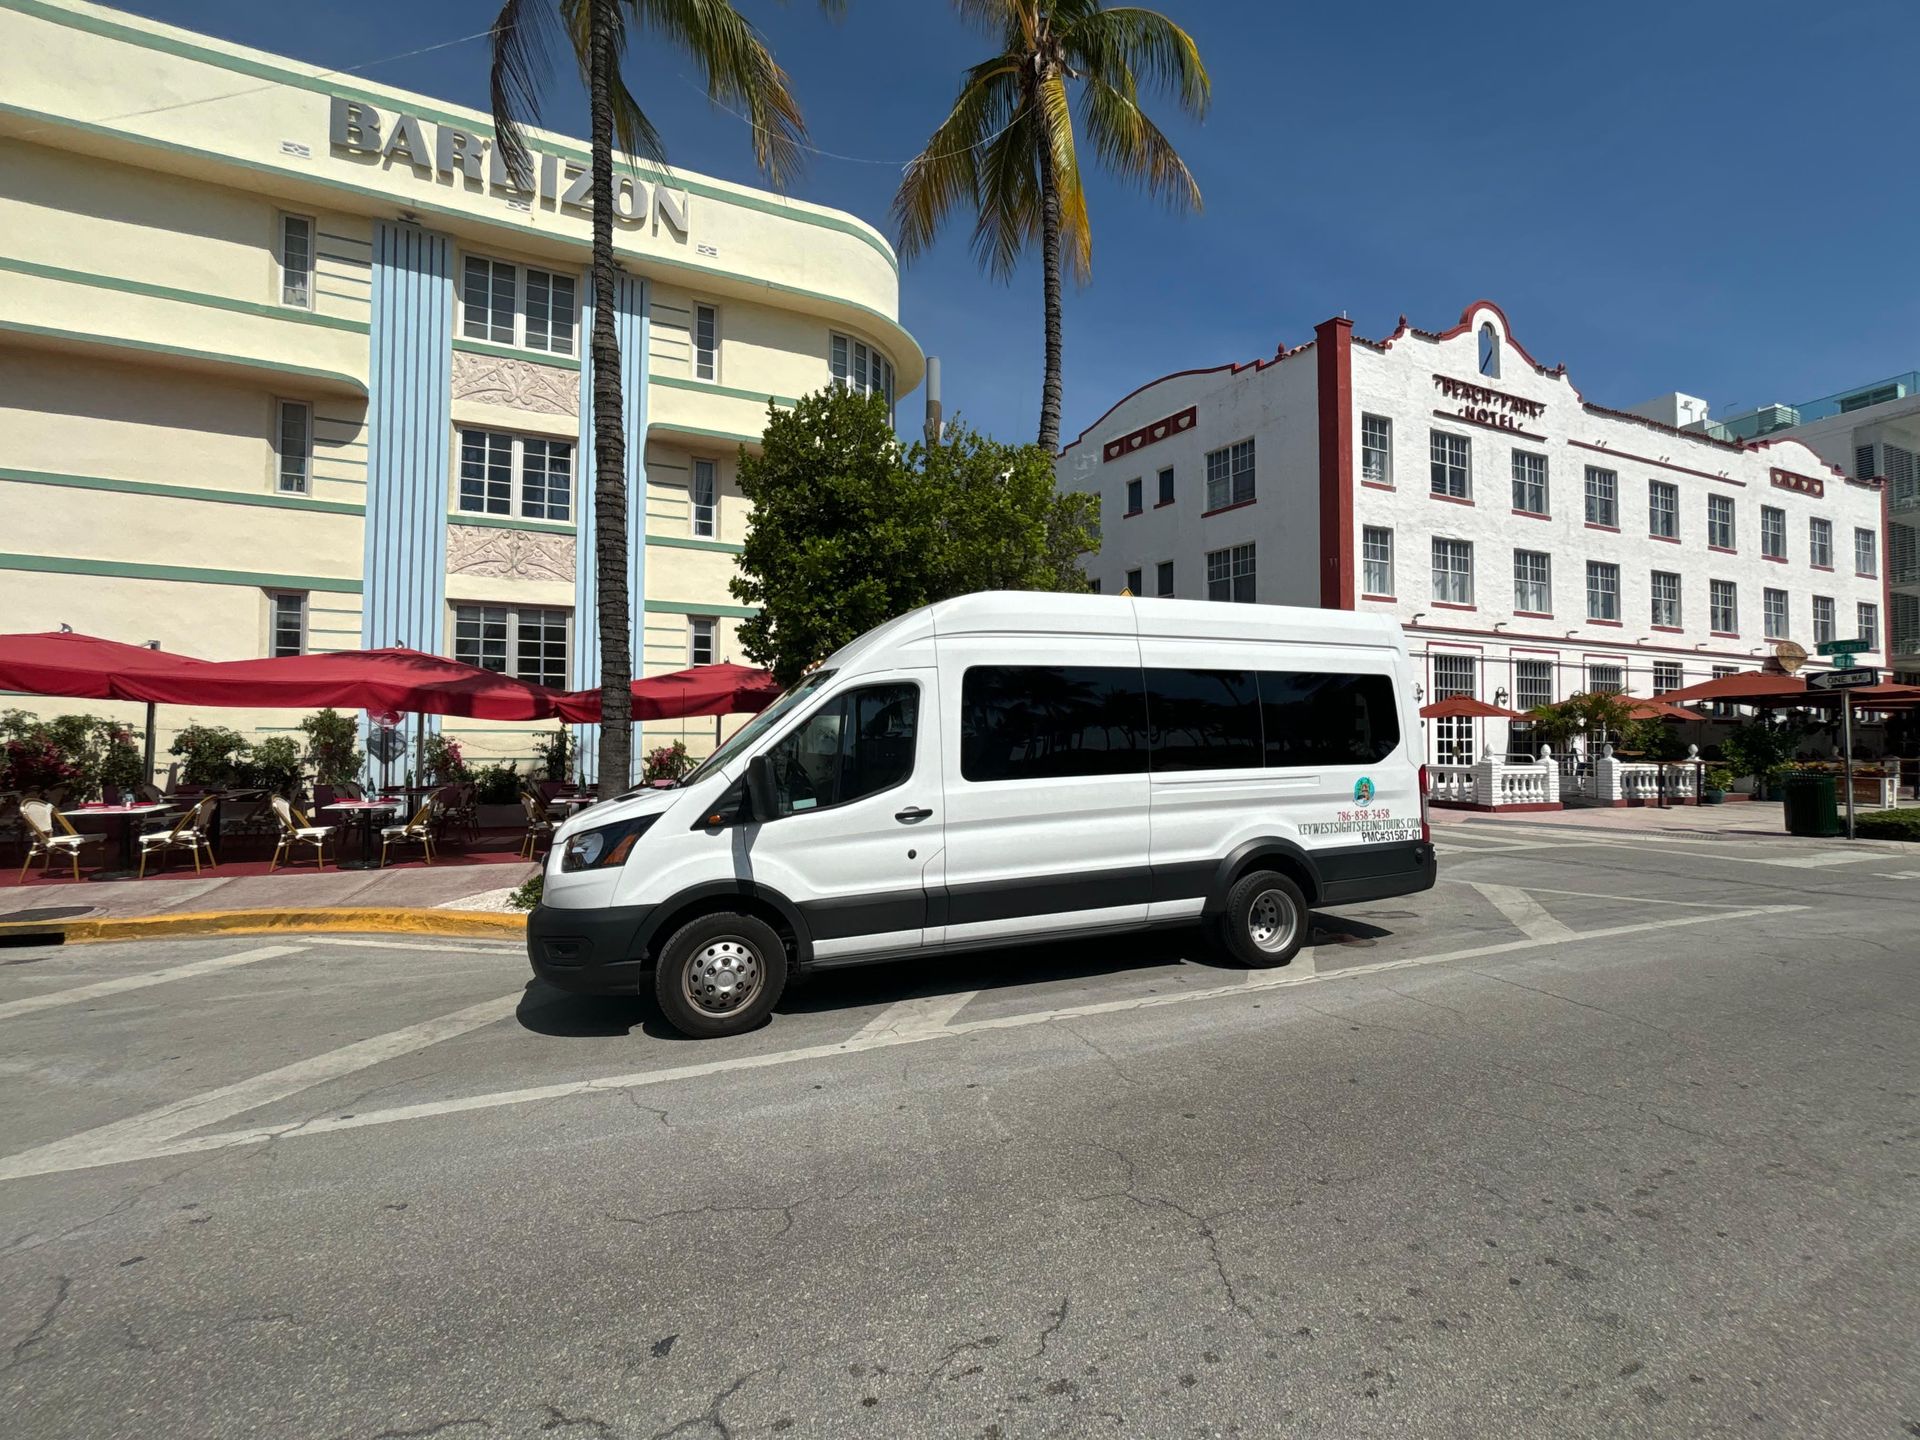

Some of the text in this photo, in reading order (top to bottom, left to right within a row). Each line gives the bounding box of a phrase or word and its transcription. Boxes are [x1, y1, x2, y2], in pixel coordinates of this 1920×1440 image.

[330, 96, 689, 235] BARBIZON
[1442, 376, 1538, 419] BEACH PARK
[1464, 405, 1518, 431] HOTEL
[1827, 675, 1847, 684] ONE
[1337, 808, 1390, 822] 786-858-3458
[1298, 818, 1421, 836] KEYWESTSIGHTSEEINGTOURS.COM
[1361, 829, 1421, 843] PMC#31587-01
